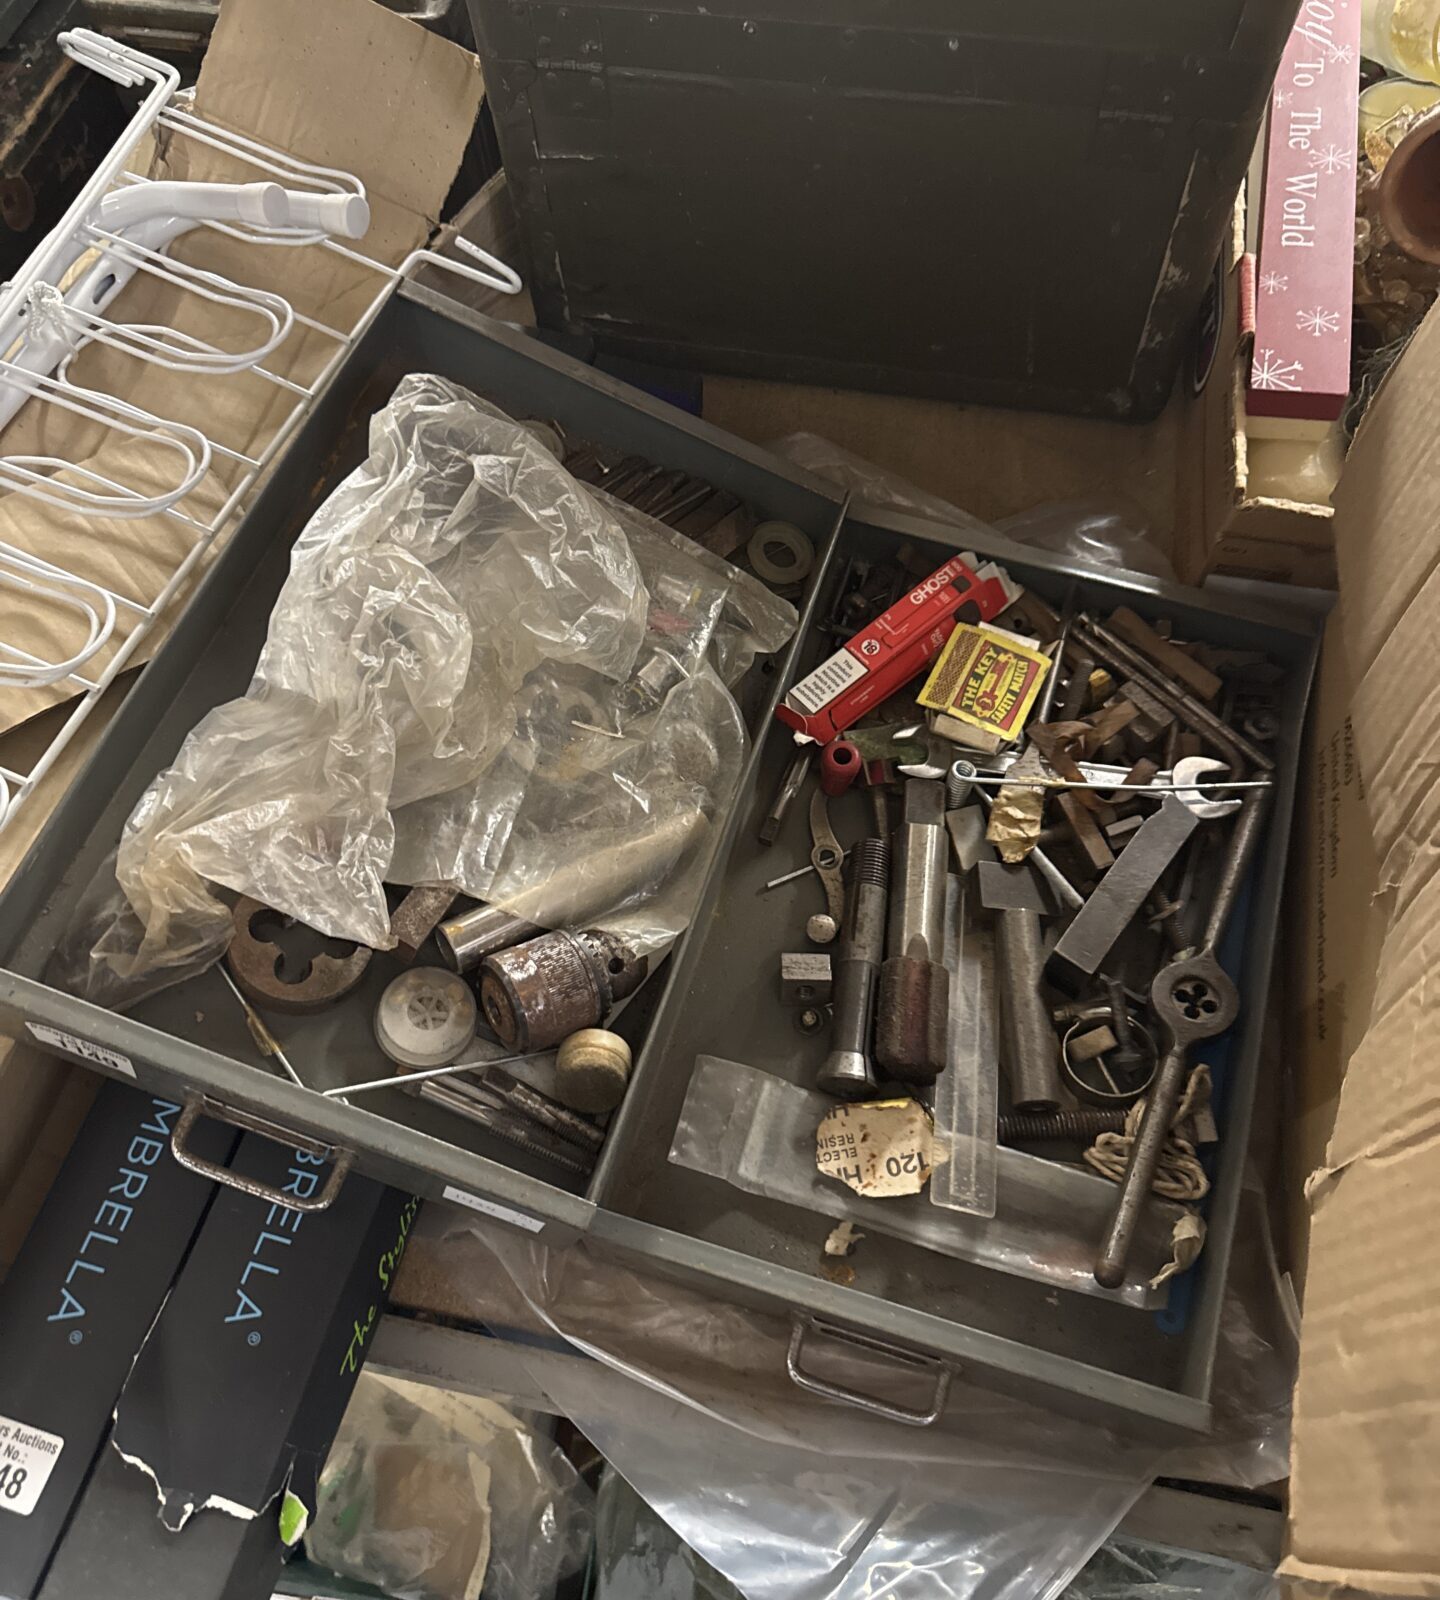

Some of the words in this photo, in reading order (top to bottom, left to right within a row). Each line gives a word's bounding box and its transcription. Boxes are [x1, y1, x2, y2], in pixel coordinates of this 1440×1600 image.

[1293, 0, 1337, 51] oy
[1292, 58, 1325, 87] To
[1288, 107, 1322, 149] The
[1281, 172, 1318, 247] World
[910, 566, 955, 604] GHOST
[863, 641, 877, 654] 18
[961, 677, 981, 707] THE
[975, 646, 998, 676] KEY
[991, 692, 1017, 723] SAFETY
[1008, 659, 1029, 692] MATCH
[816, 1147, 858, 1164] ELECT
[886, 1151, 930, 1178] 120
[340, 1305, 377, 1376] The
[379, 1195, 420, 1290] Stylis
[12, 1428, 59, 1455] Auctions
